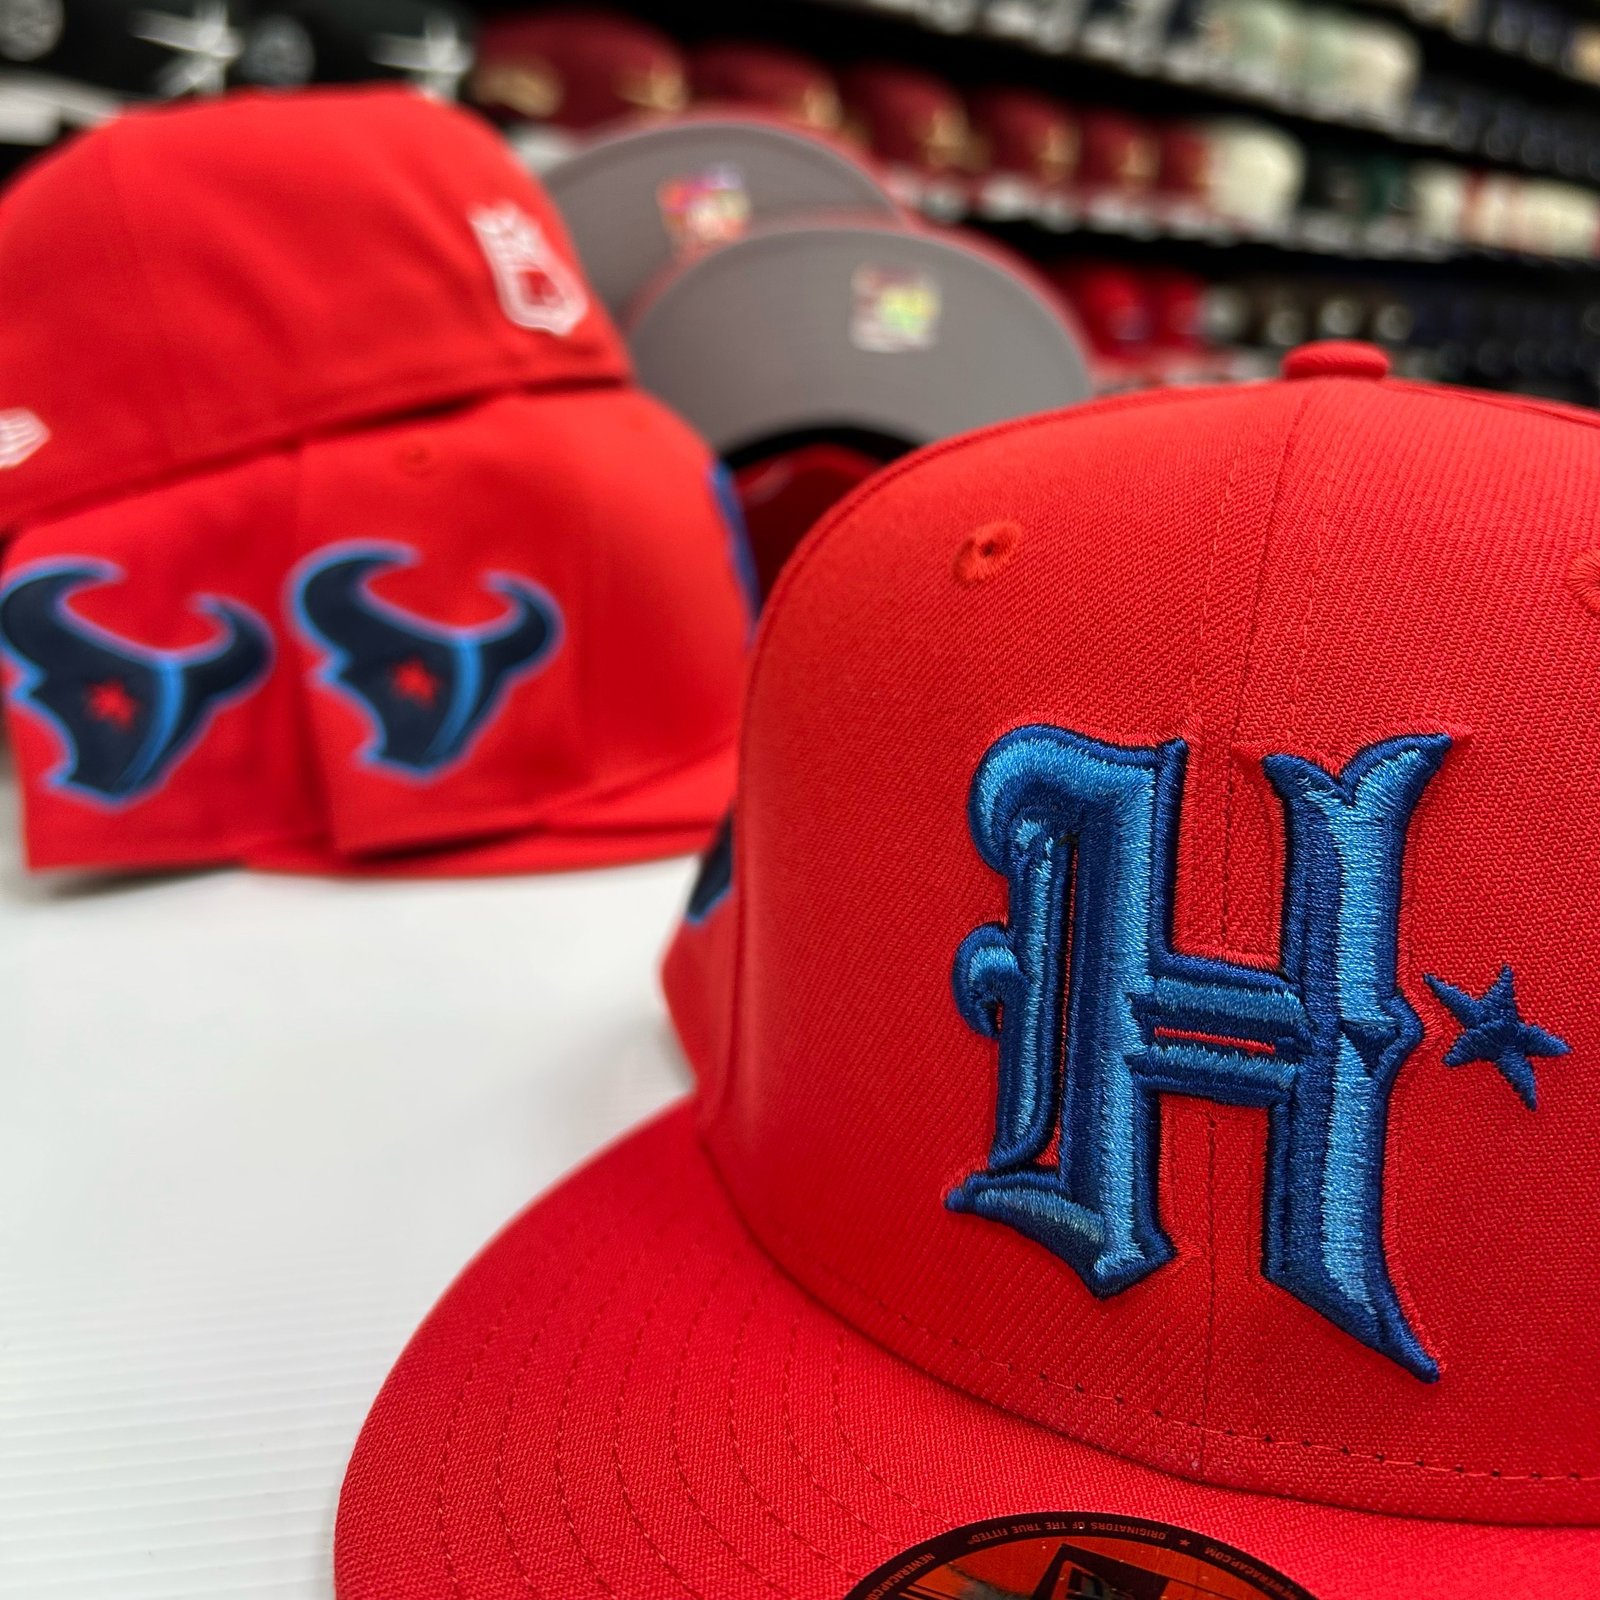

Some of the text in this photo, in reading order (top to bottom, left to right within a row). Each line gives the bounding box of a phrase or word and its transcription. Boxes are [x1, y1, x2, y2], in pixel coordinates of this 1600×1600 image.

[944, 723, 1453, 1384] H
[1011, 1522, 1041, 1534] TRUE
[1044, 1520, 1067, 1530] THE
[1071, 1520, 1086, 1531] OF
[1090, 1522, 1167, 1541] ORIGINATORS
